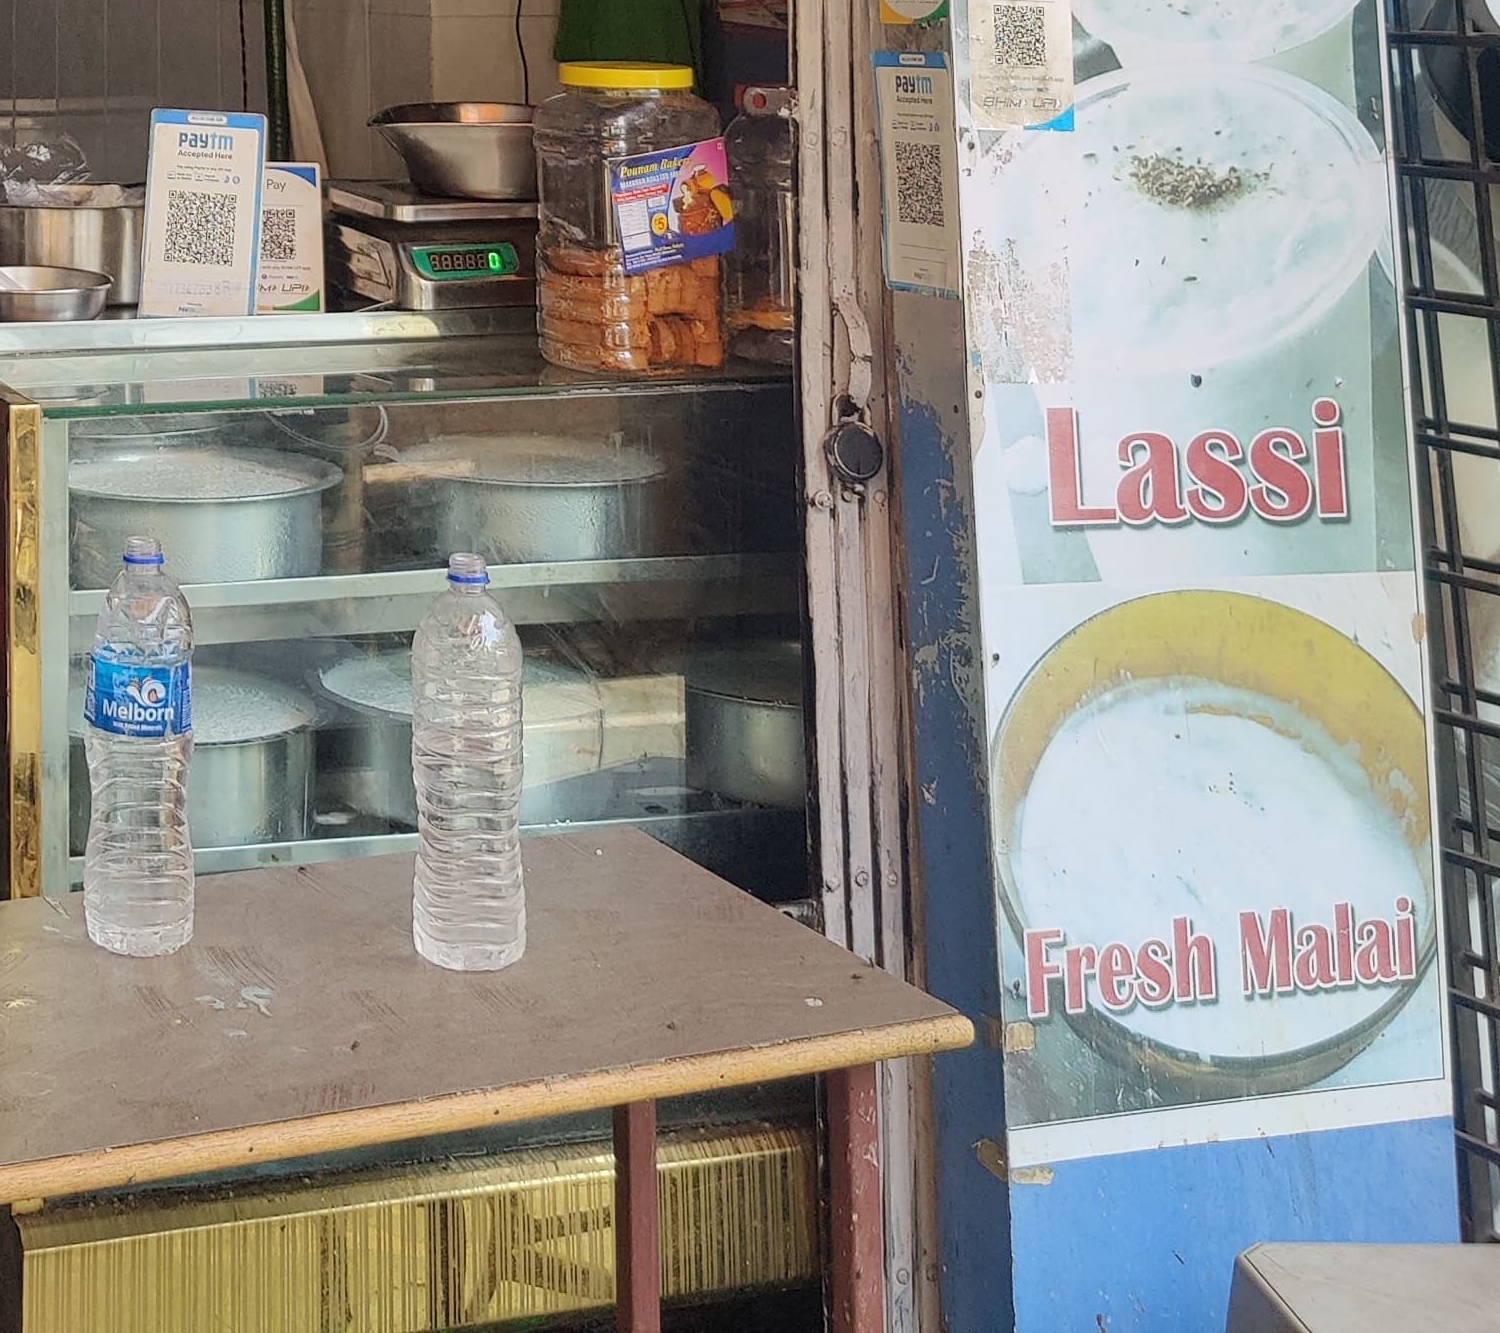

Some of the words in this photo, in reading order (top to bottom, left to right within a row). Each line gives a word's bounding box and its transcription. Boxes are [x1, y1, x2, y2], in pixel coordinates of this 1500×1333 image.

[177, 149, 213, 160] Accepted
[214, 151, 233, 160] Here
[266, 178, 286, 193] Pay
[1045, 397, 1349, 529] Lassi
[103, 699, 174, 721] Melborn
[1023, 915, 1217, 1019] Fresh
[1239, 896, 1417, 999] Malai
